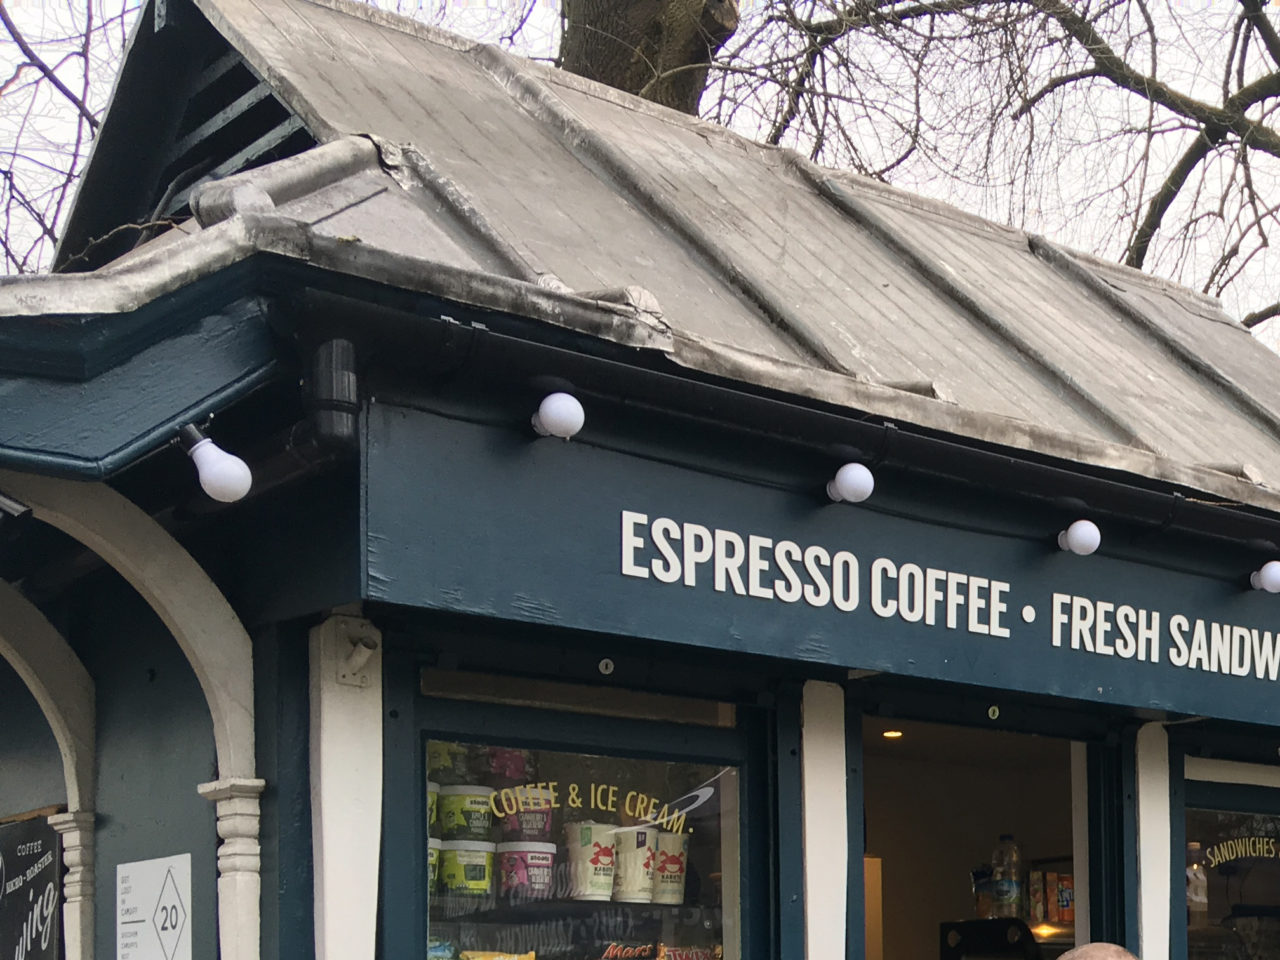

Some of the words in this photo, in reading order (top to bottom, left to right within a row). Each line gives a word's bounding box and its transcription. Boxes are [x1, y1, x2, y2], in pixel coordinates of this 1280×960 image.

[621, 510, 859, 612] ESPRESSO
[870, 557, 1010, 637] COFFEE
[1052, 593, 1160, 663] FRESH
[489, 782, 560, 818] COFFEE
[568, 784, 582, 808] &
[590, 783, 618, 812] ICE
[625, 791, 686, 835] CREAM
[17, 841, 42, 856] COFFEE
[1206, 837, 1275, 867] SANDWICHES
[161, 904, 178, 931] 20
[601, 942, 653, 960] Mars
